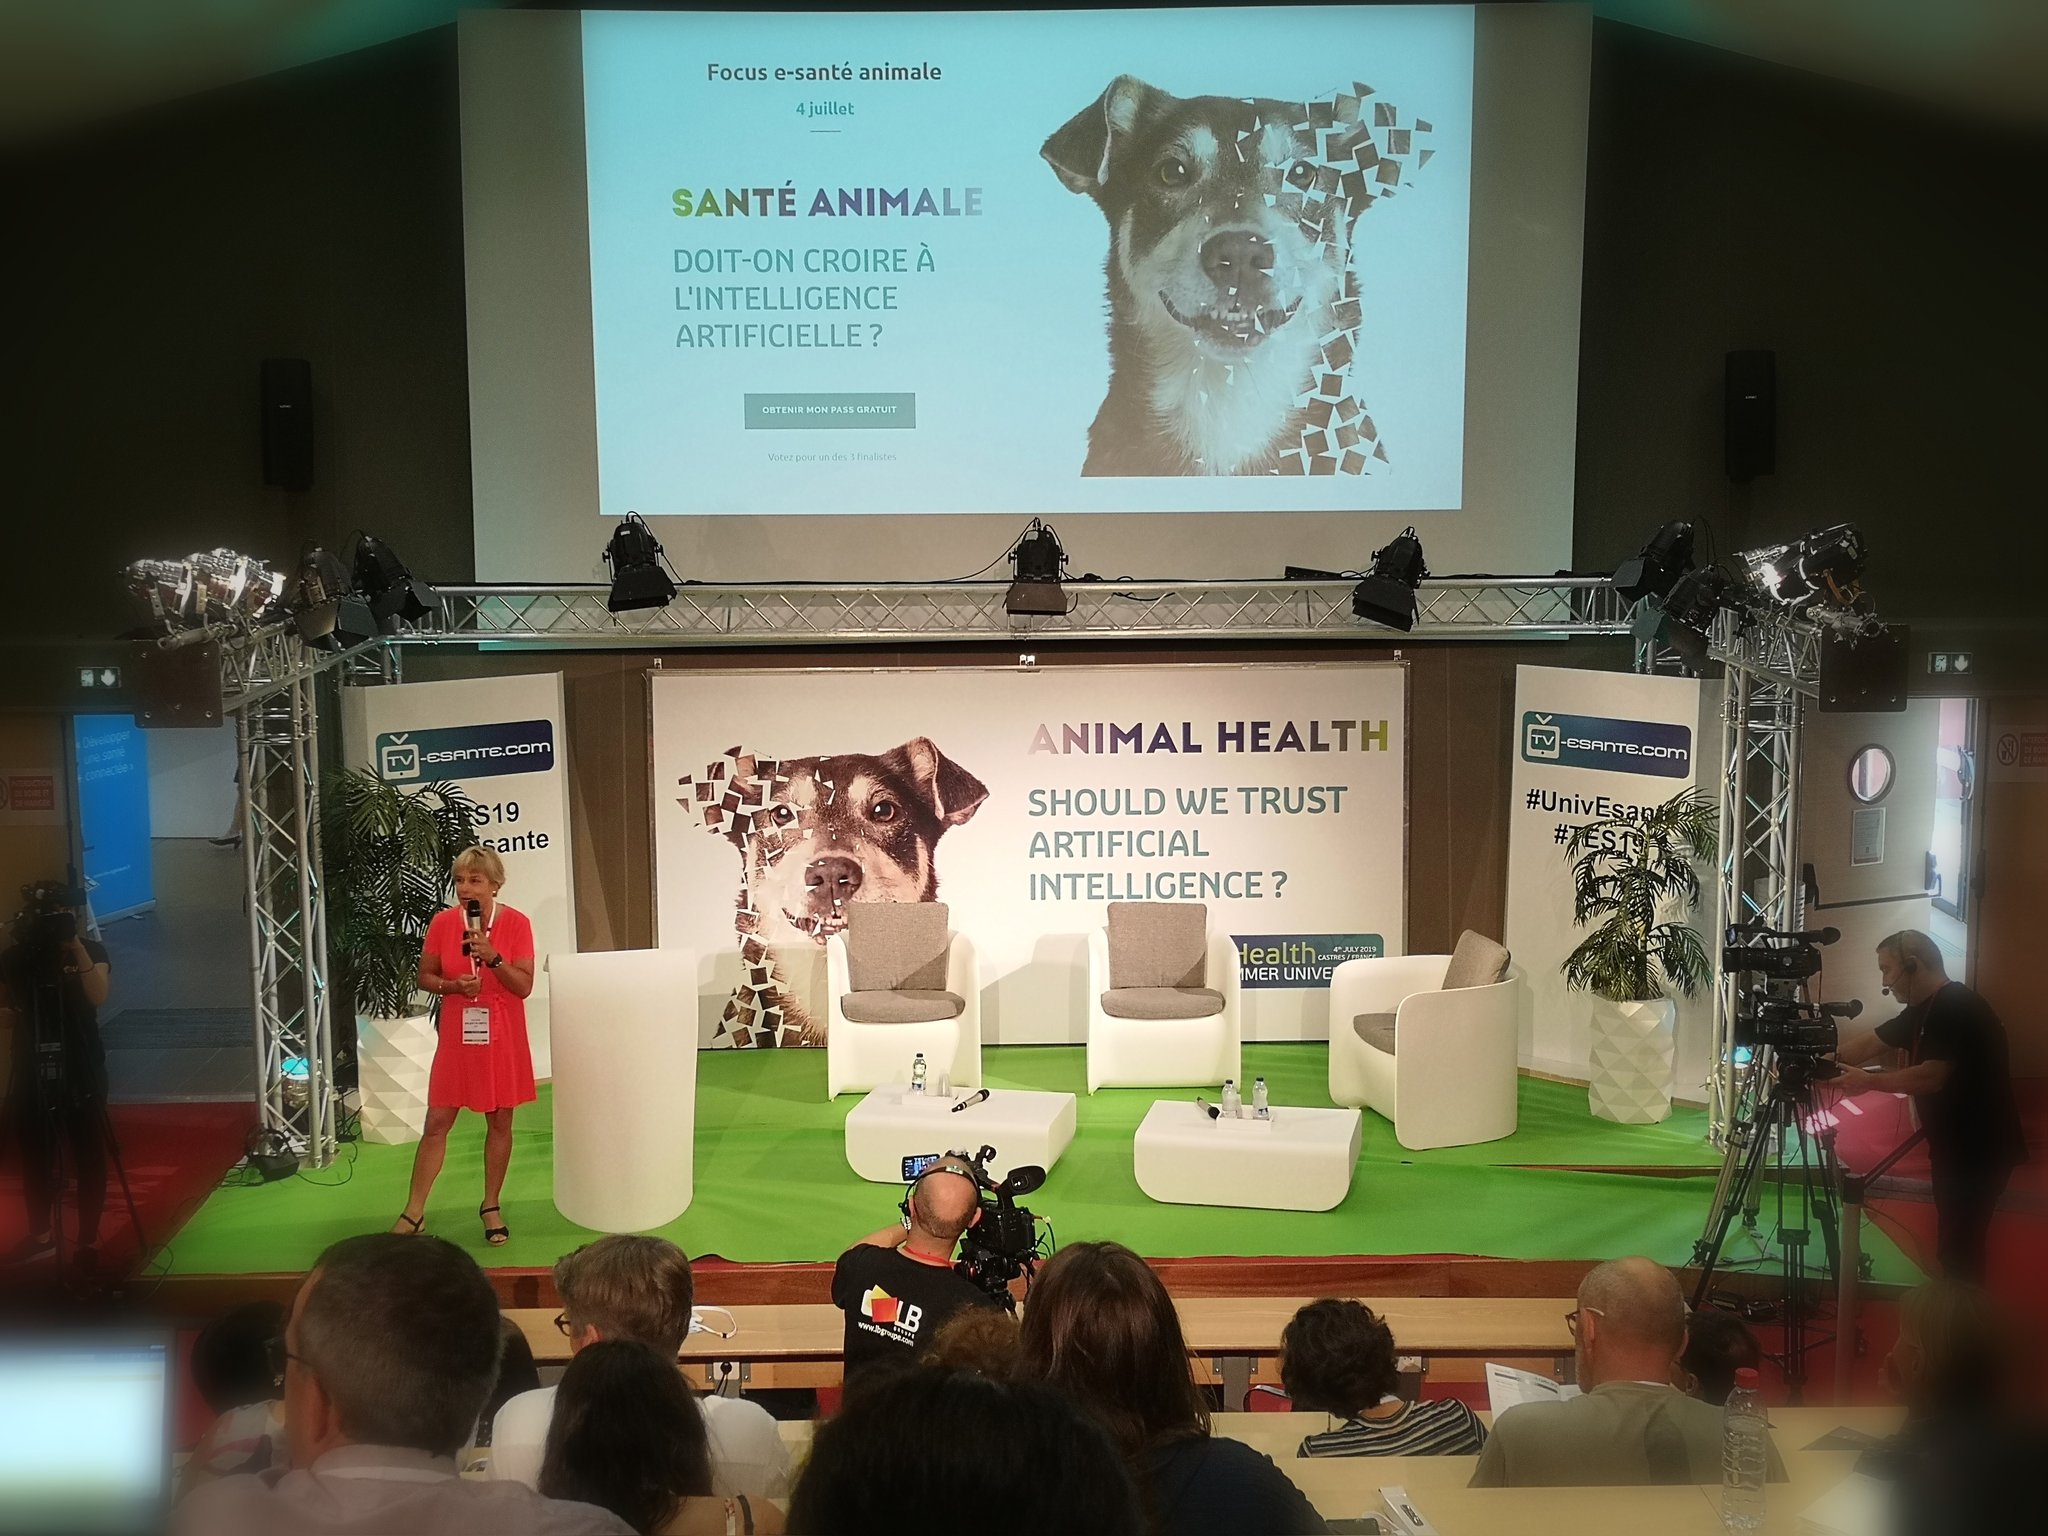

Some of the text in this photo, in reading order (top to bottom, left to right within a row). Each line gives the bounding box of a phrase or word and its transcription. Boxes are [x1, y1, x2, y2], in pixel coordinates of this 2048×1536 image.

[707, 60, 942, 81] Focus e-santé animale
[796, 101, 855, 118] 4 juillet
[672, 180, 983, 217] SANTÉ ANIMALE
[673, 242, 936, 273] DOIT-ON CROIRE À
[675, 286, 898, 311] L'INTELLIGENCE
[675, 323, 862, 348] ARTIFICIELLE
[762, 405, 897, 414] OBTENIR MON PASS GRATUIT
[768, 452, 794, 462] Votez
[795, 454, 816, 463] pour
[832, 452, 848, 461] des
[857, 452, 897, 461] finalistes
[1028, 720, 1389, 755] ANIMAL HEALTH
[475, 801, 520, 826] S19
[1028, 786, 1348, 817] SHOULD WE TRUST
[1526, 788, 1656, 822] #UnivEsan
[481, 830, 549, 854] sante
[1029, 829, 1210, 858] ARTIFICIAL
[1029, 871, 1263, 901] INTELLIGENCE
[894, 1300, 923, 1333] LB
[858, 1321, 914, 1347] www.lbgroupe.com
